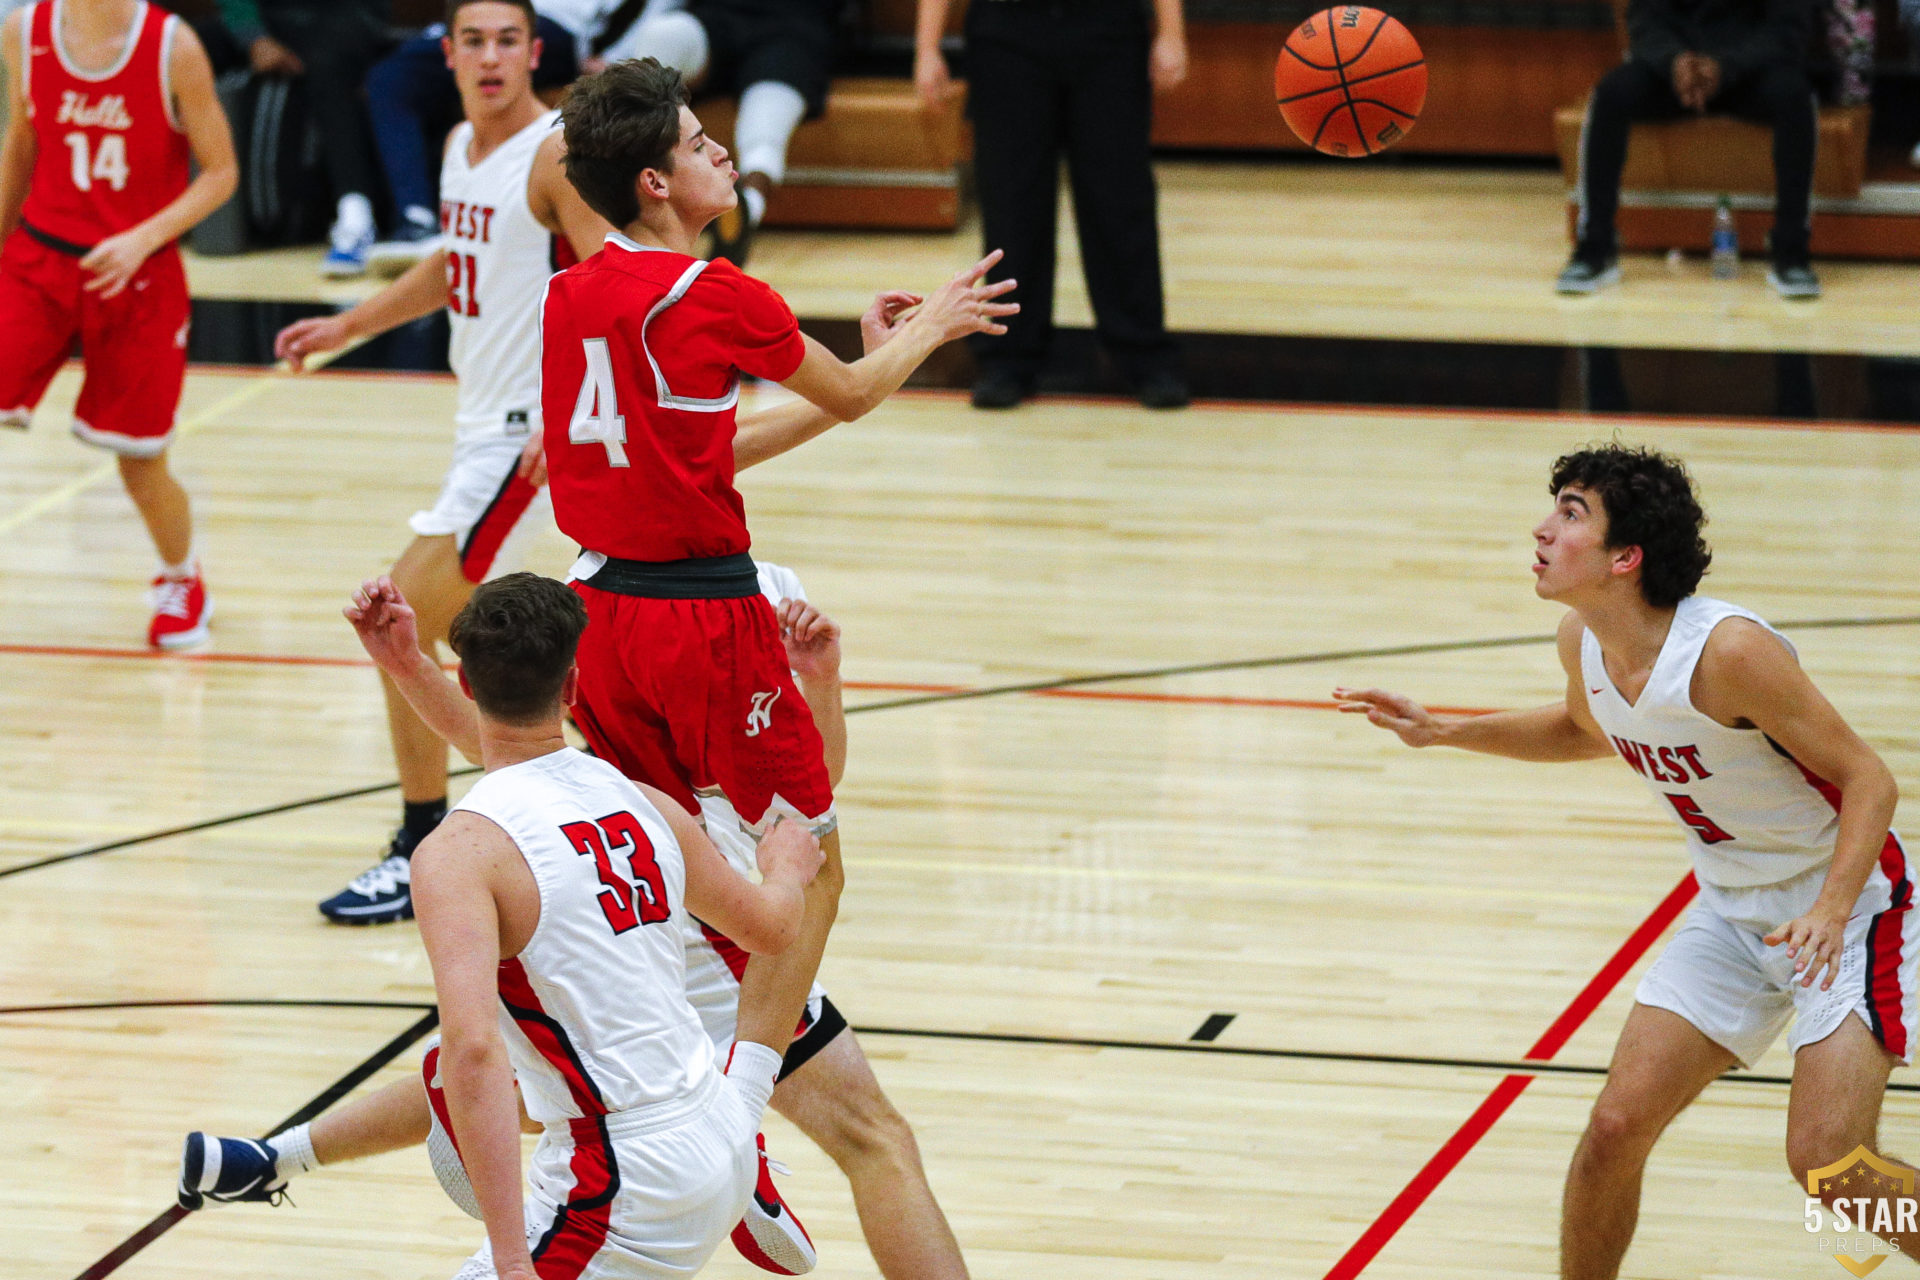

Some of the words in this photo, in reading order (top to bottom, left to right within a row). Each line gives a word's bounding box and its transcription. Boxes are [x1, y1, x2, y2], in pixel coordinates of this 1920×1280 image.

[64, 132, 130, 191] 14
[447, 251, 480, 317] 21
[568, 337, 631, 468] 4
[1611, 734, 1713, 784] WEST
[1663, 792, 1736, 845] 5
[558, 810, 671, 936] 33
